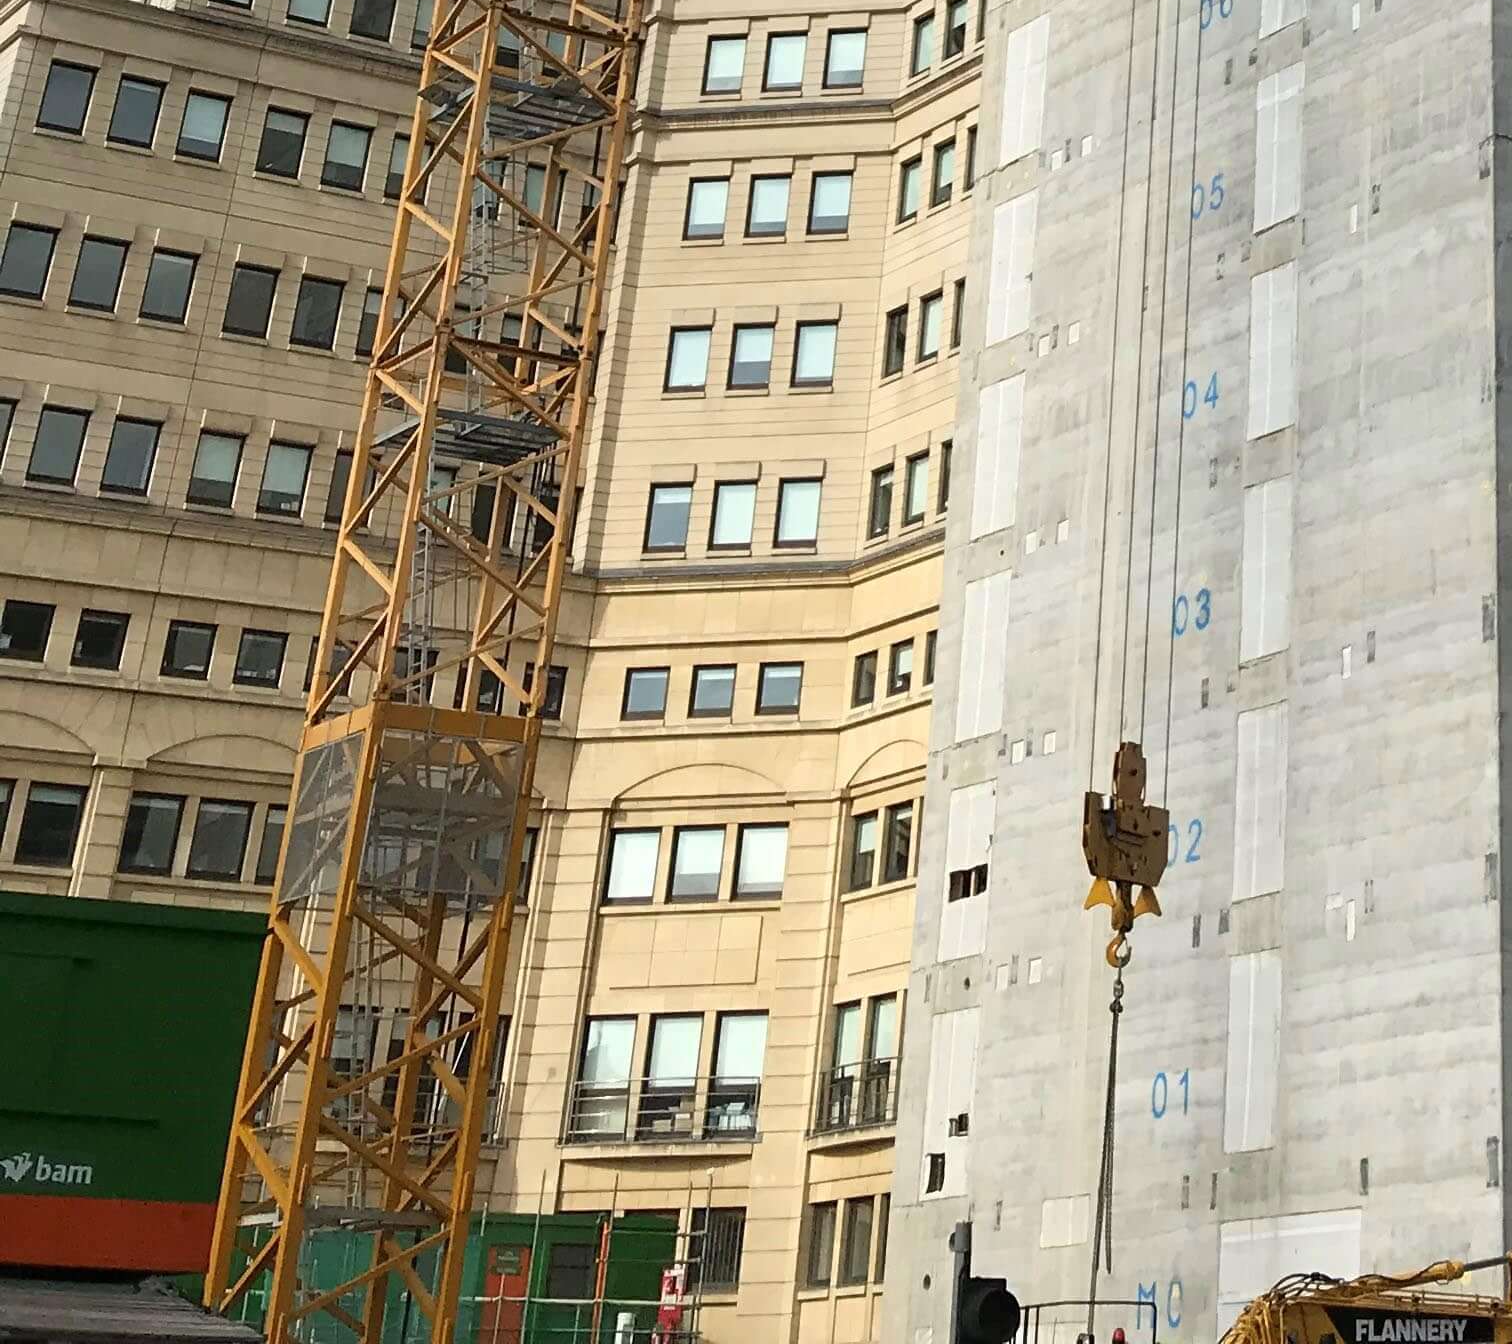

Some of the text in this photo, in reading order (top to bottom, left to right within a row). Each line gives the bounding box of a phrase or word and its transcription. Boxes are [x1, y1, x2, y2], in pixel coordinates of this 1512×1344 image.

[1191, 173, 1225, 219] 05
[1182, 371, 1220, 419] 04
[1172, 589, 1211, 638] 03
[1151, 1068, 1190, 1118] 01
[35, 1155, 93, 1184] bam
[1355, 1319, 1467, 1342] FLANNERY
